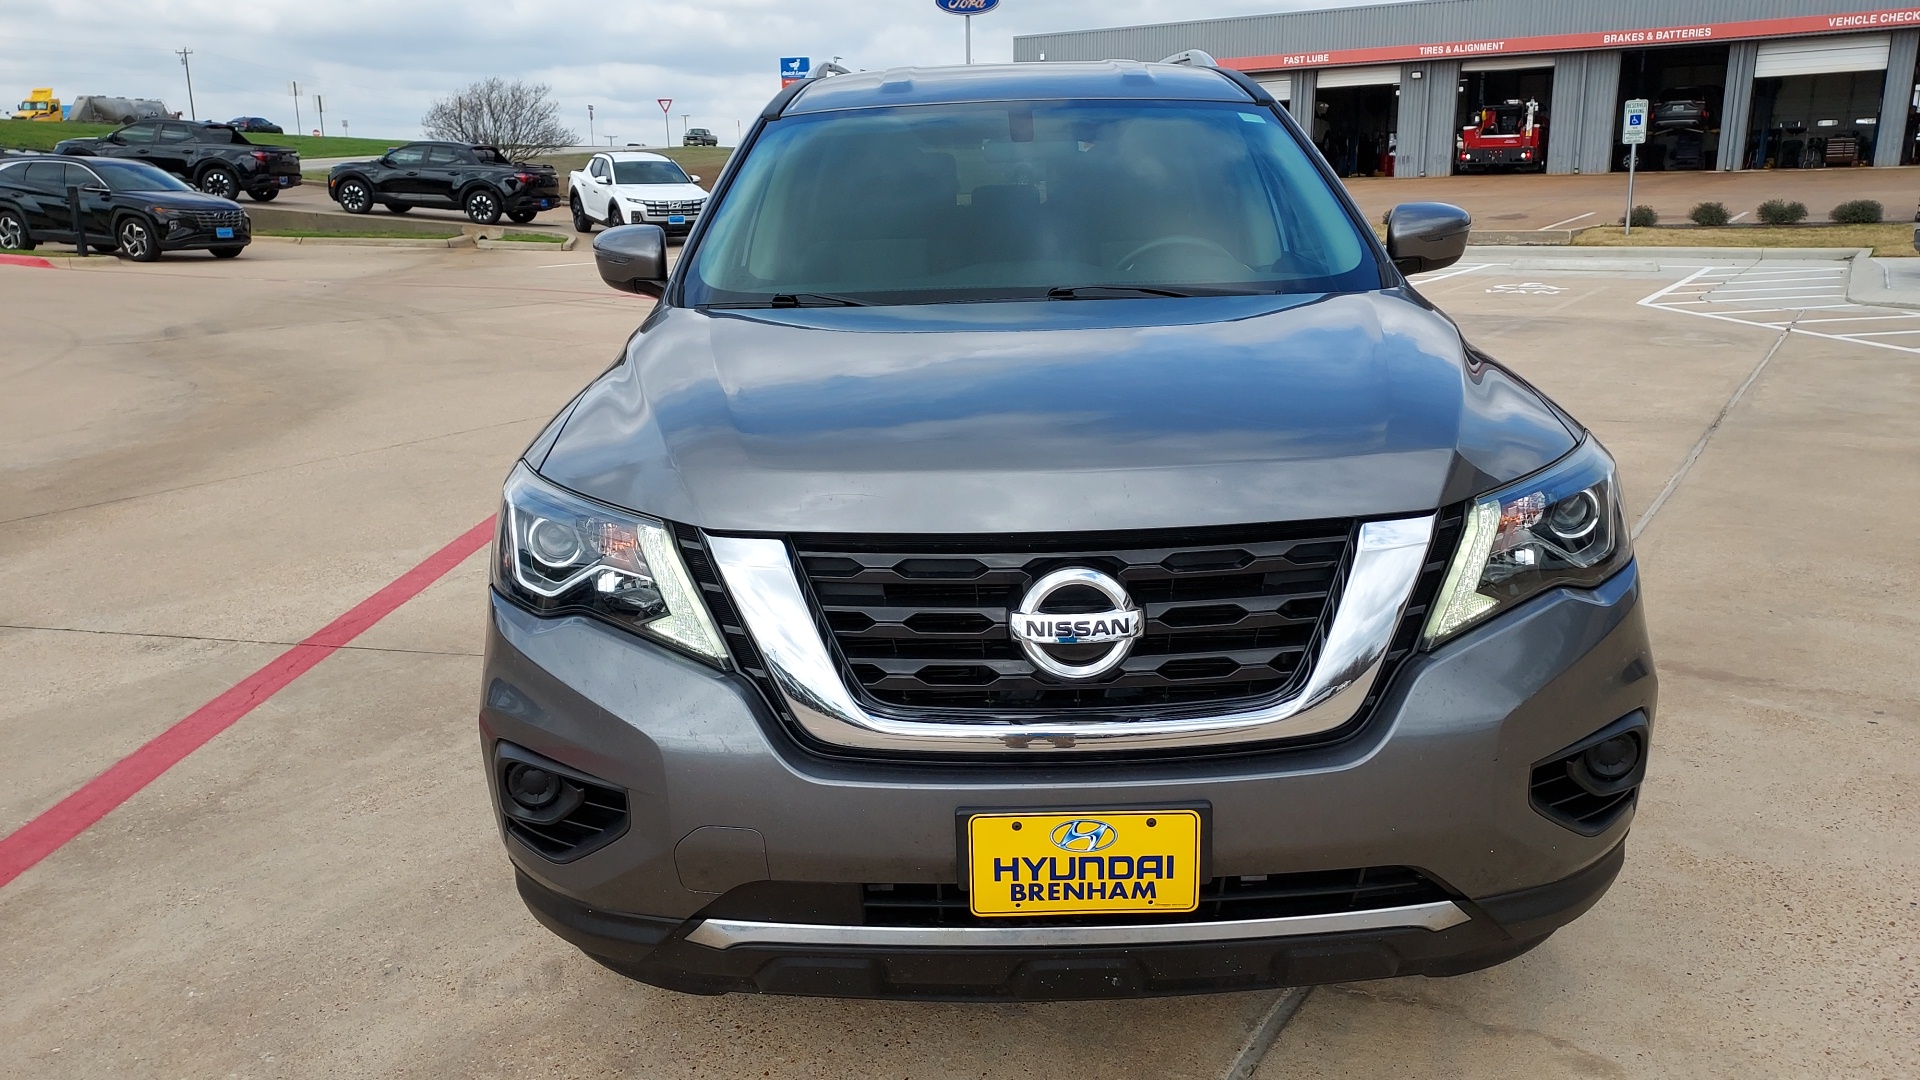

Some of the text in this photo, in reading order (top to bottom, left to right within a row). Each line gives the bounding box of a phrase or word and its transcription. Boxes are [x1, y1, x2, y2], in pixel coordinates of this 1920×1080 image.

[1828, 14, 1877, 27] VEHICLE
[1603, 27, 1712, 43] BRAKES & BATTERIES
[1419, 41, 1505, 55] TIRES & ALIGNMENT
[1283, 53, 1329, 64] FAST LUBE
[1026, 617, 1130, 637] NISSAN
[994, 855, 1174, 882] HYUNDAI
[1010, 881, 1157, 902] BRENHAM
